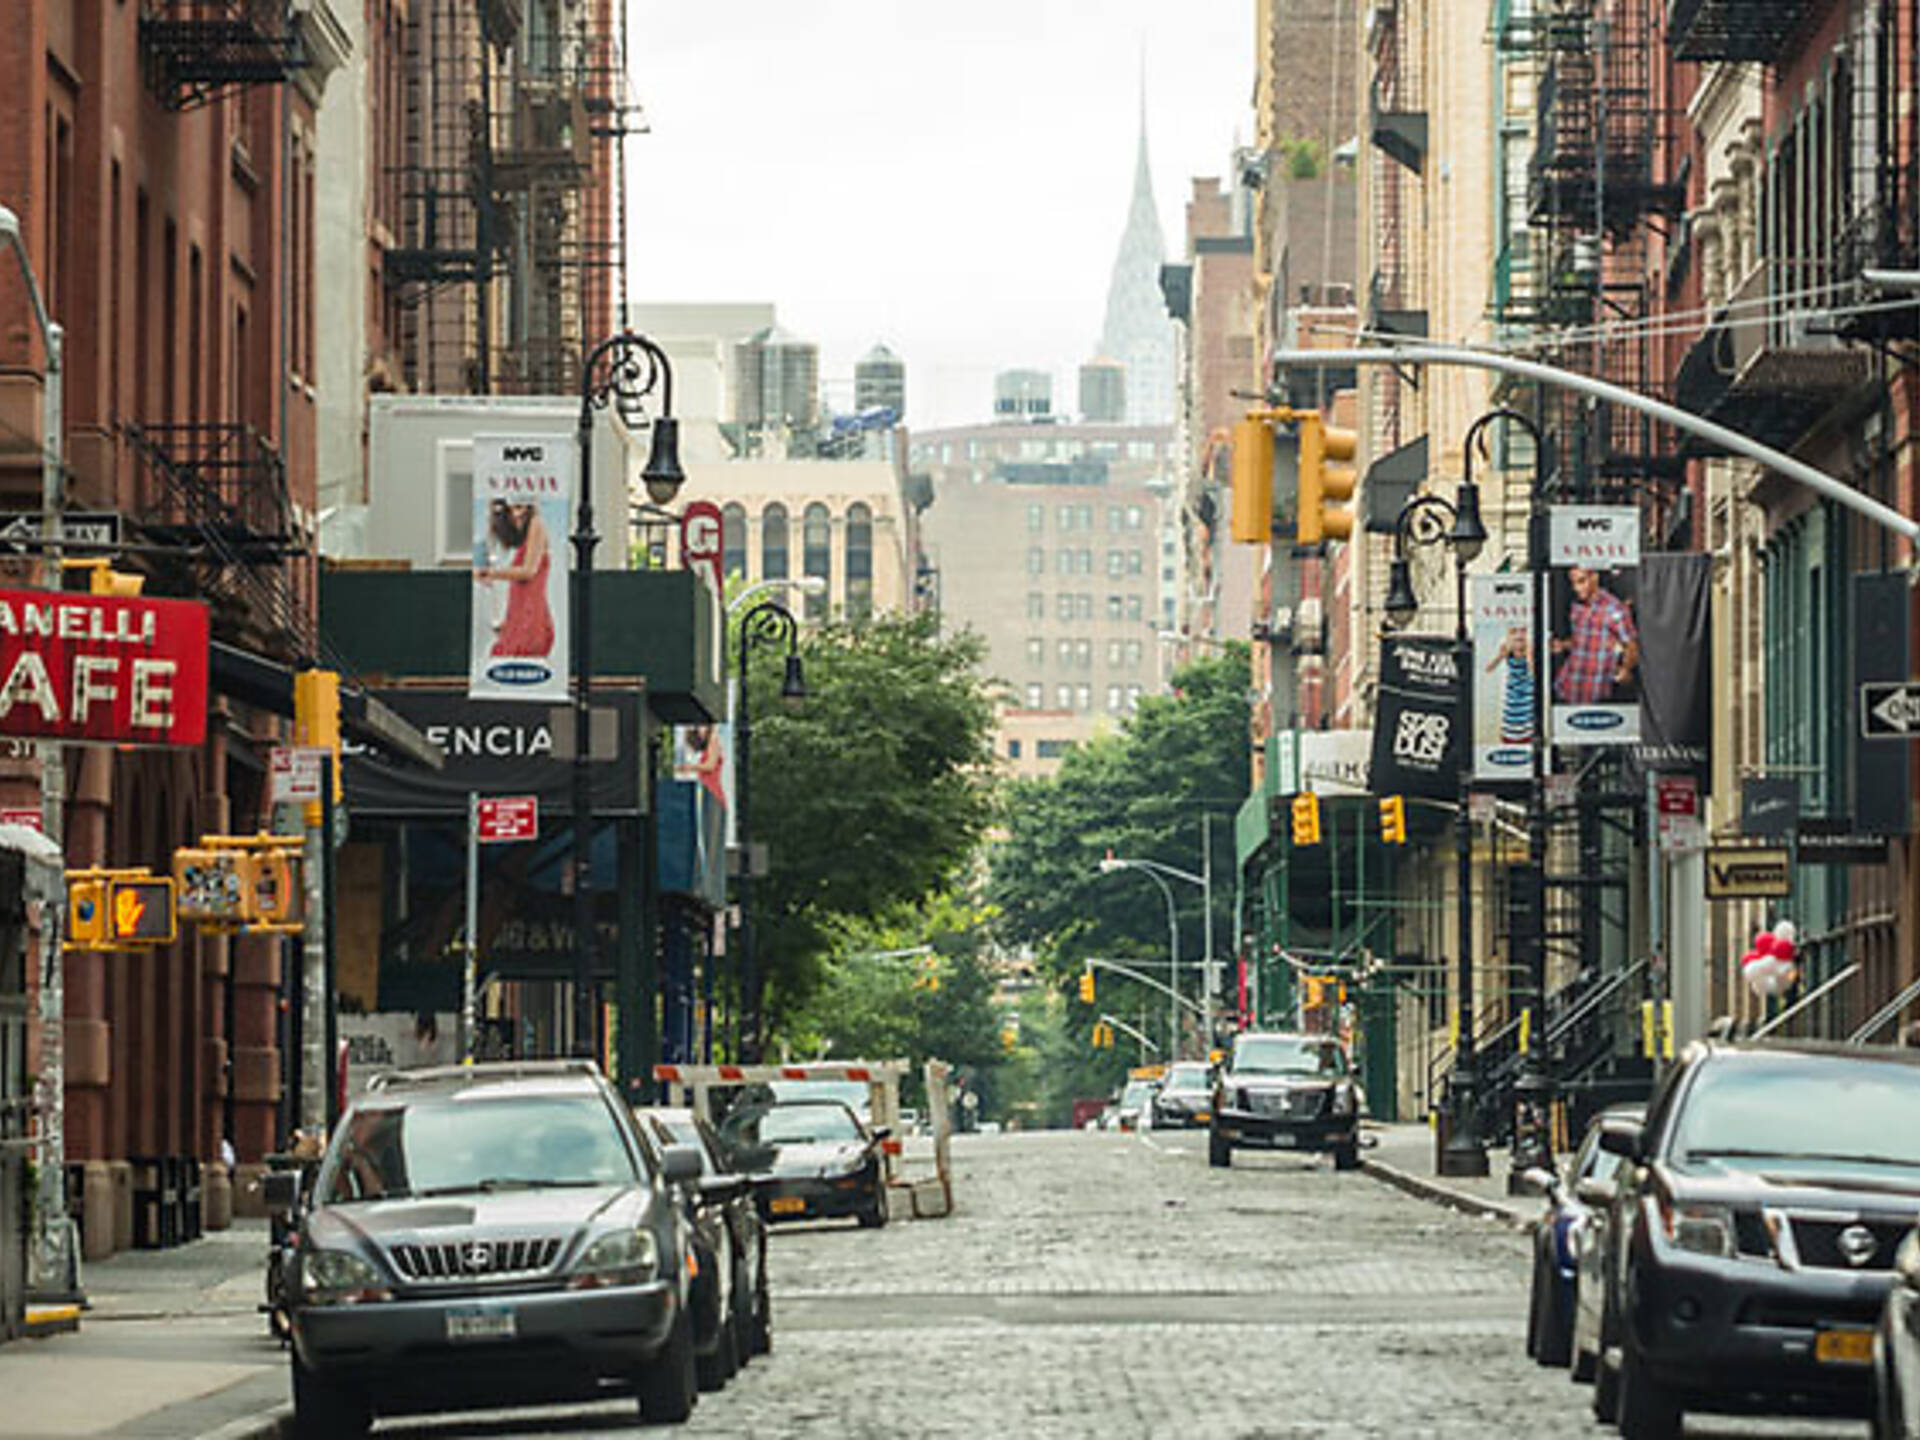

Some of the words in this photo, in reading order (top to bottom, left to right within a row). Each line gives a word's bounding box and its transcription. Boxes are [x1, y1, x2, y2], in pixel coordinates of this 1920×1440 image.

[503, 446, 544, 462] NYC
[0, 602, 156, 645] ANELLI
[0, 650, 178, 728] AFE
[1888, 699, 1920, 721] ON
